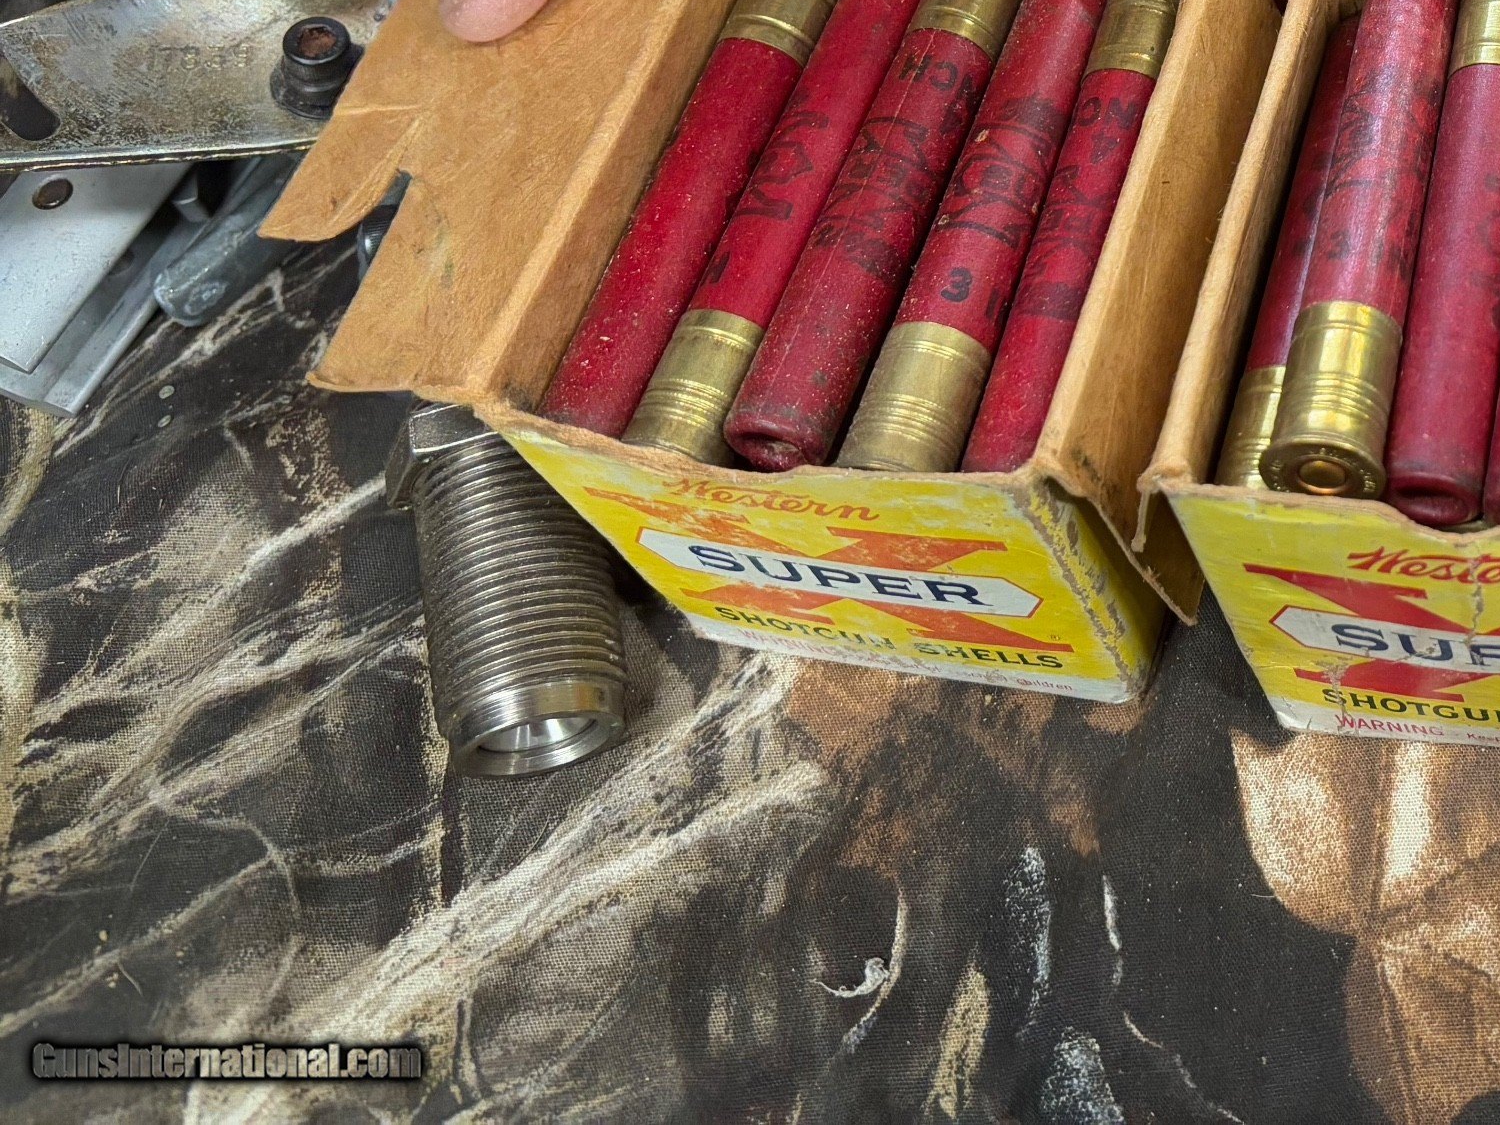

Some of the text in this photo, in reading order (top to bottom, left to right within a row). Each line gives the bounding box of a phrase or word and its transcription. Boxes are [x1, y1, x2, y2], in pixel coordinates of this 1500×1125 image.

[940, 267, 973, 303] 3
[662, 477, 880, 522] Western
[687, 544, 995, 608] SUPER
[913, 642, 1064, 668] SHELLS
[1334, 714, 1445, 737] WARNING
